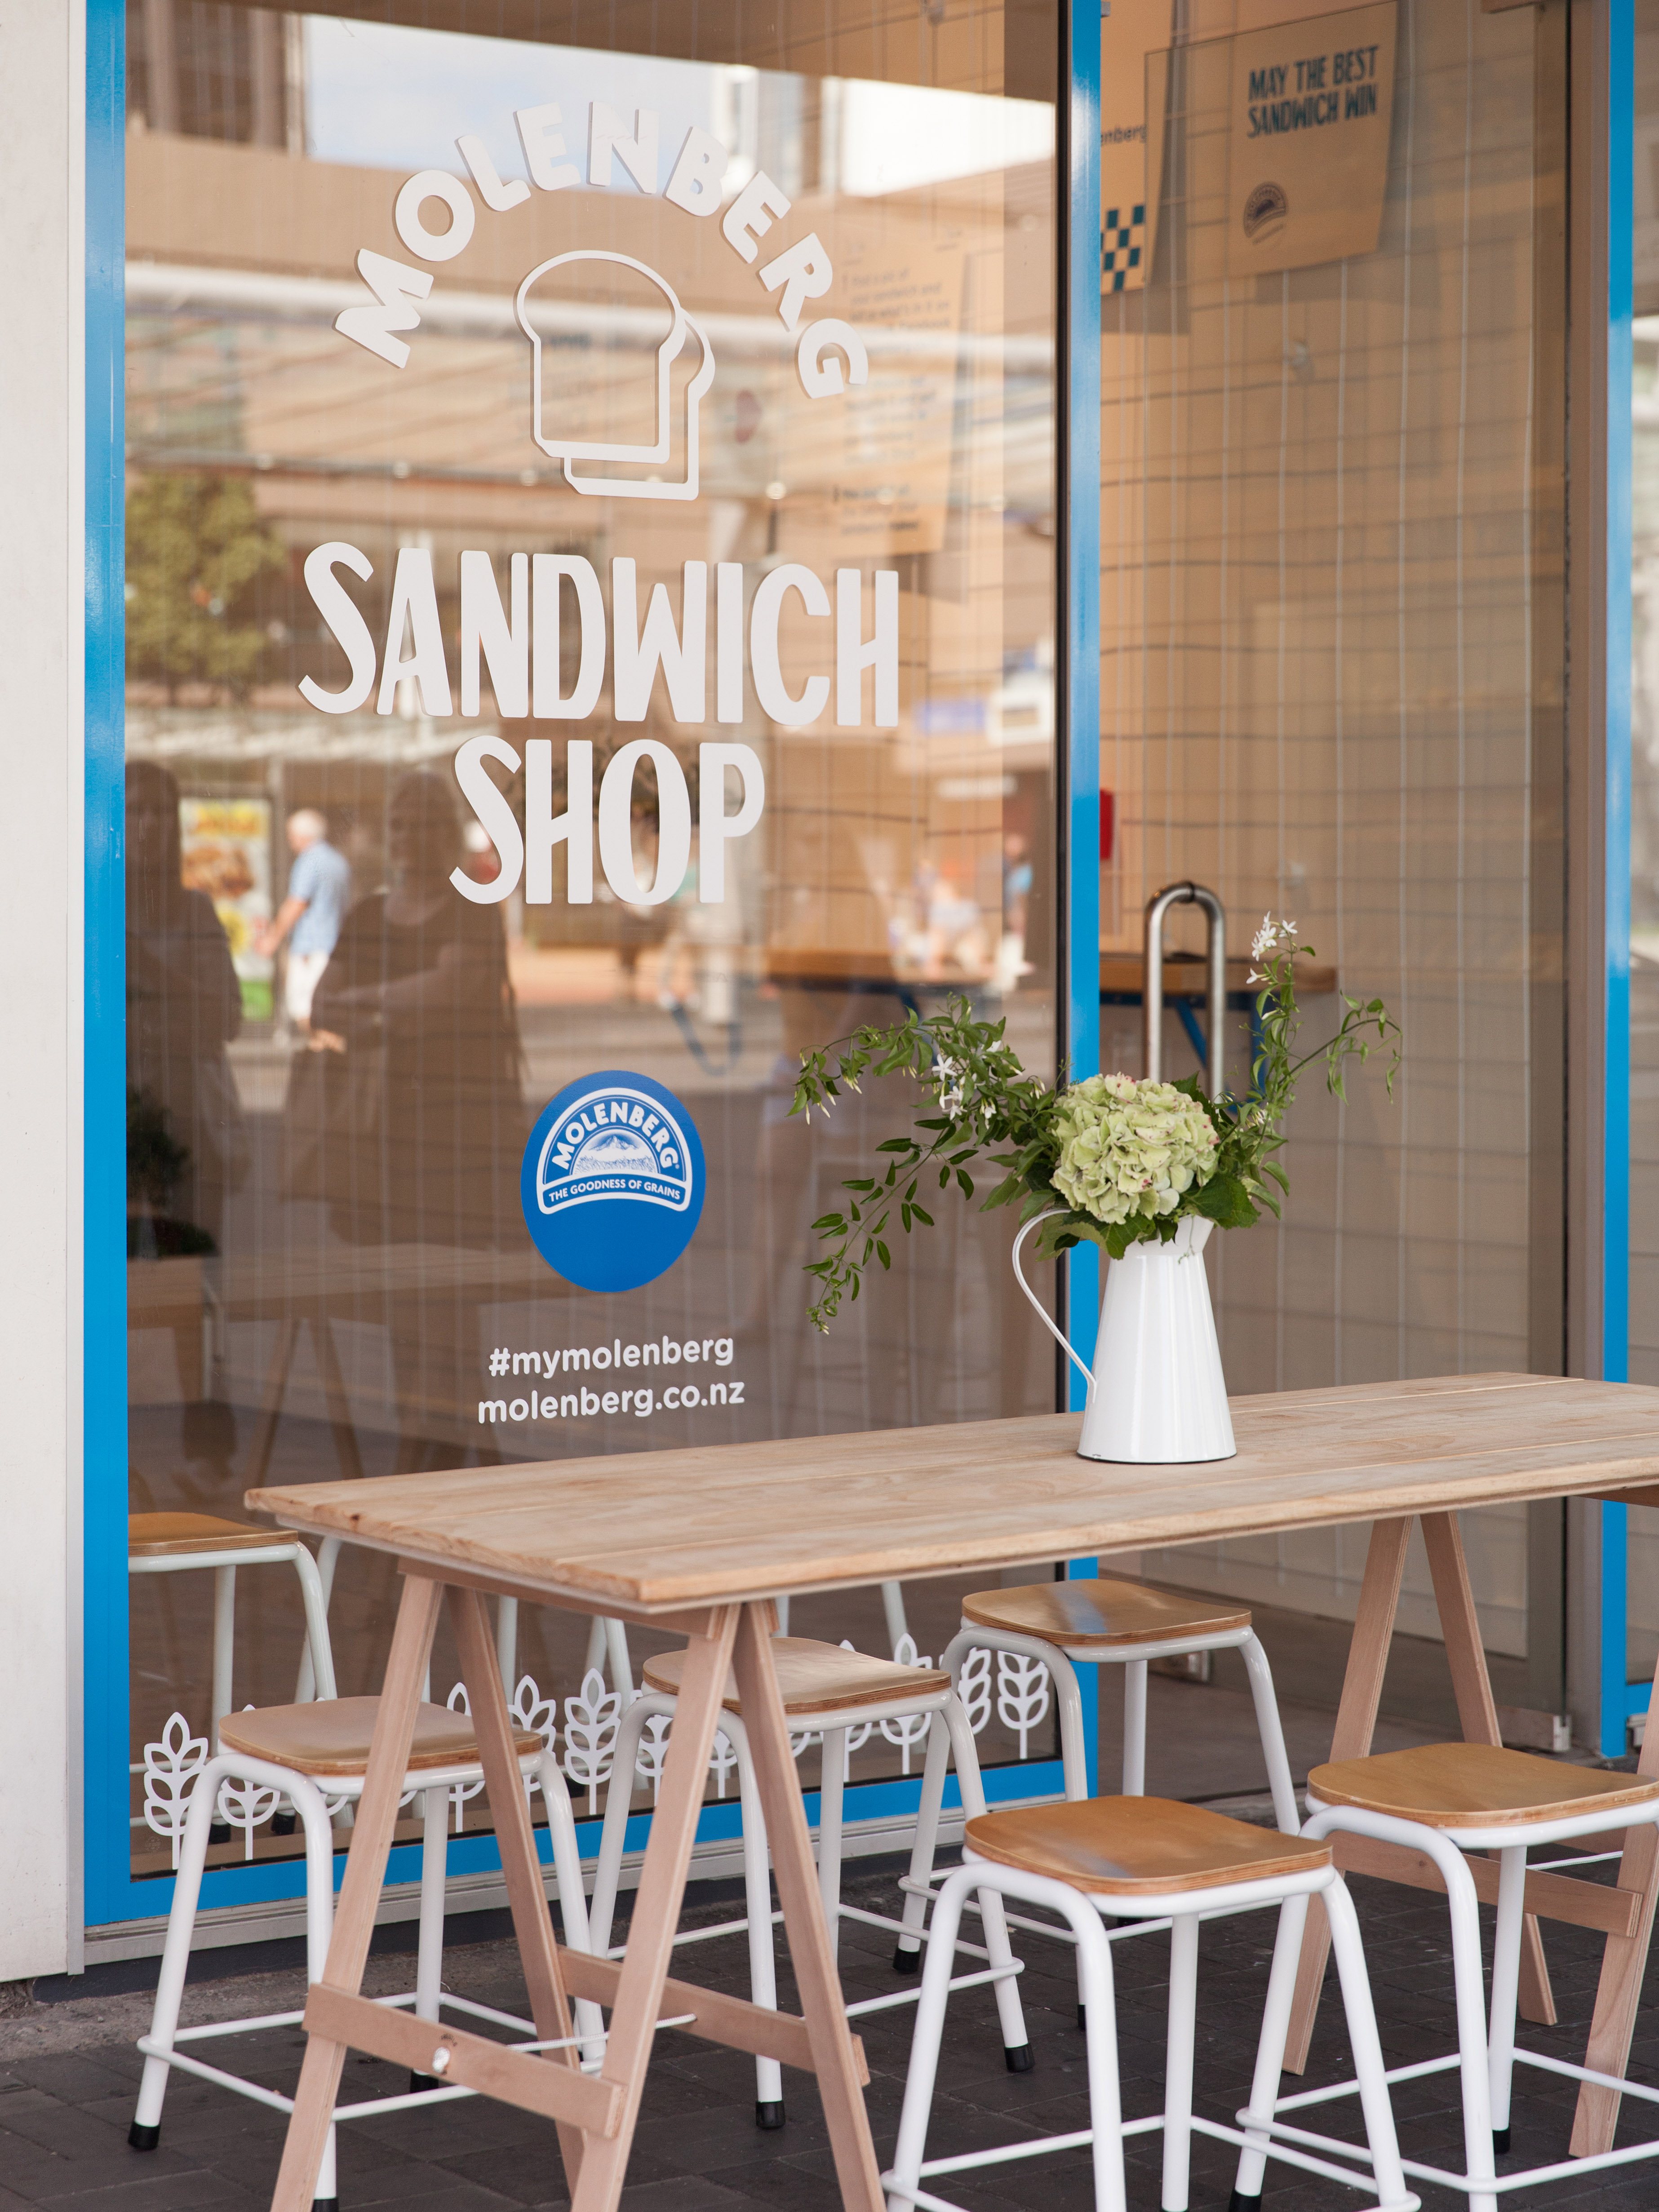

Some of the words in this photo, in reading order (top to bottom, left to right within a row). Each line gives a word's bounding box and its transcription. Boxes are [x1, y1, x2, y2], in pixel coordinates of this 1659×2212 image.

[1249, 65, 1289, 103] MAY
[1294, 54, 1326, 93] THE
[1333, 45, 1379, 85] BEST
[1247, 92, 1339, 139] SANDWICH
[1344, 84, 1377, 120] WIN
[335, 102, 868, 399] MOLENBERG
[297, 541, 898, 727] SANDWICH
[448, 736, 765, 905] SHOP
[552, 1102, 679, 1170] MOLENBERG
[549, 1189, 568, 1202] THE
[570, 1179, 625, 1194] GOODNESS
[629, 1179, 642, 1189] OF
[644, 1182, 680, 1200] GRAINS
[488, 1336, 734, 1379] #mymolenberg
[478, 1382, 745, 1424] molenberg.co.nz
